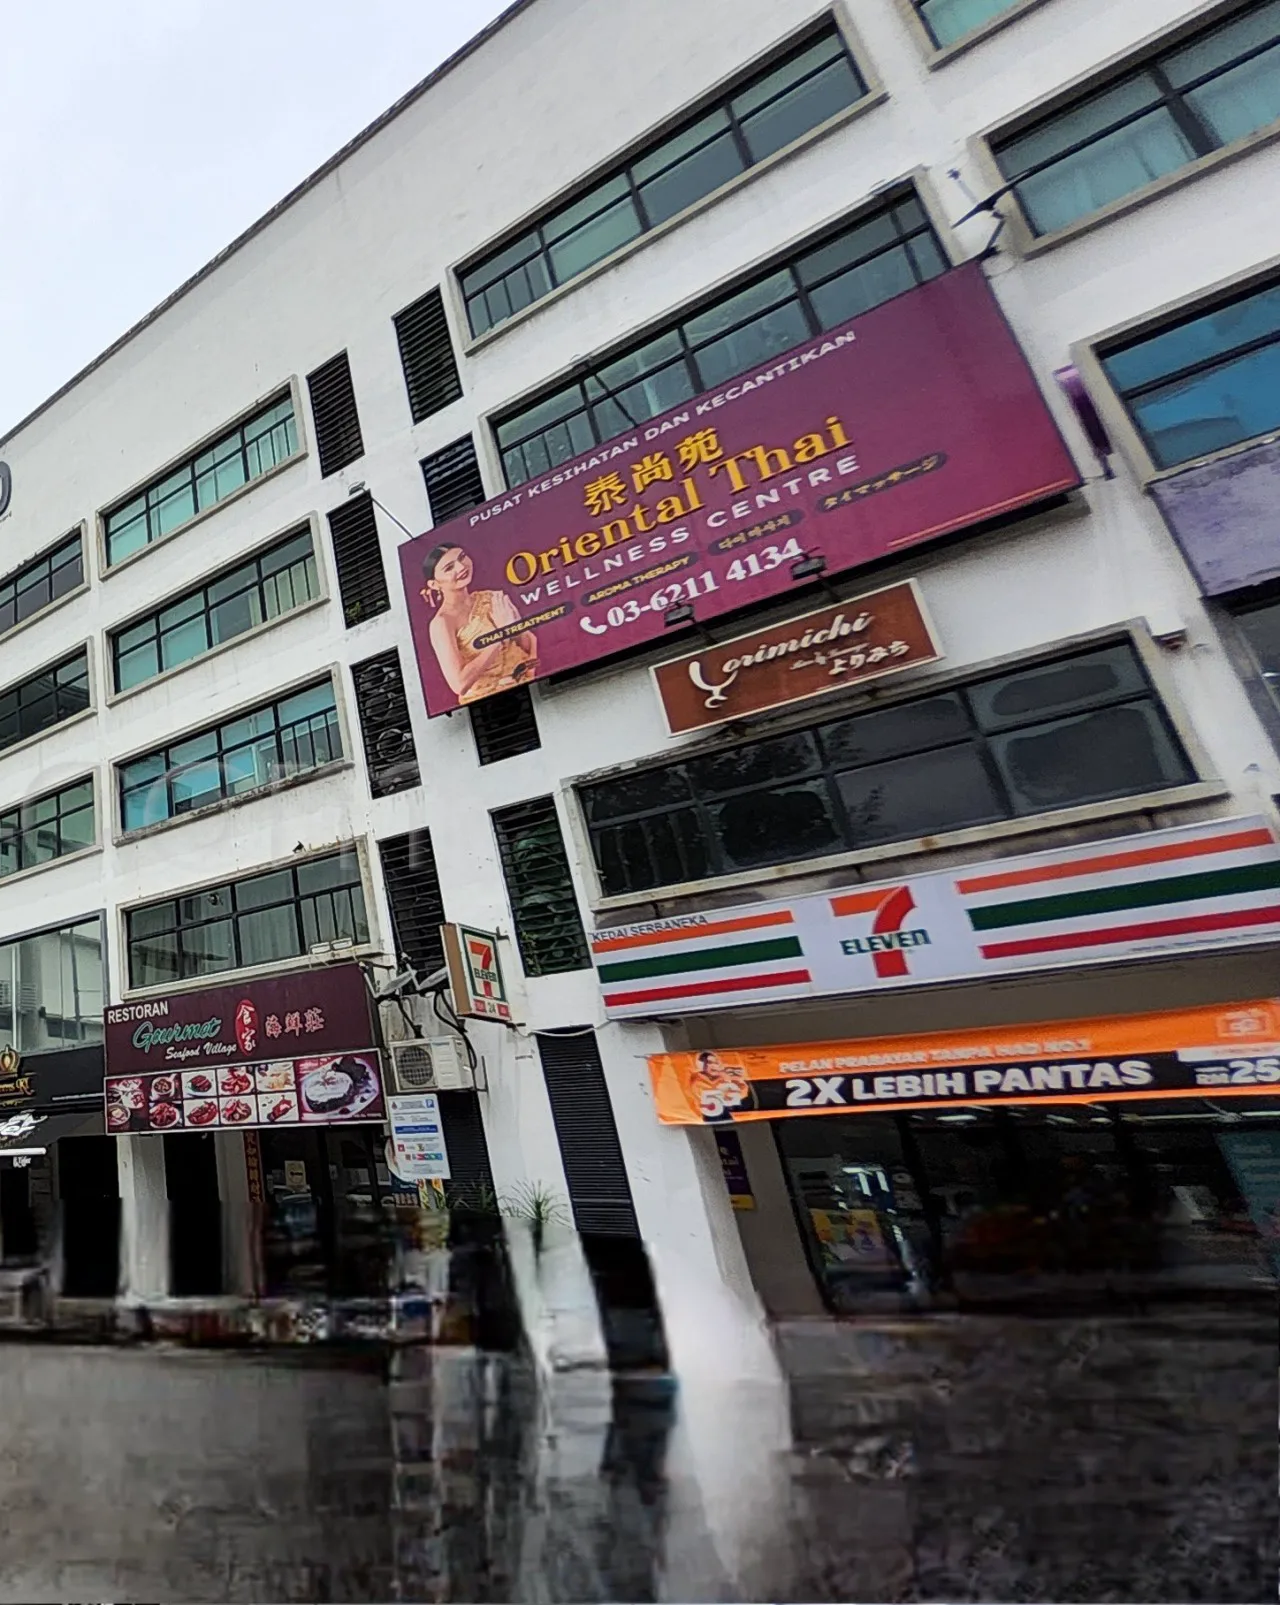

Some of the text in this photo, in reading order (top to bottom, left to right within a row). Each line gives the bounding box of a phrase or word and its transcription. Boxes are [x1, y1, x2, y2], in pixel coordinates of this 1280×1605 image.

[469, 330, 857, 527] PUSAT KESIHATAN DAN KECANTIKAN
[583, 426, 724, 517] 泰尚苑
[505, 415, 853, 586] Oriental Thai
[520, 454, 861, 606] WELLNESS CENTRE
[588, 555, 690, 602] AROMA THERAPY
[607, 537, 805, 628] 03-6211 4134
[479, 605, 567, 646] THAI TREATMENT
[828, 640, 911, 676] よりみち
[590, 914, 709, 944] KEDAI SERBANEKA
[829, 885, 917, 979] 7
[469, 940, 493, 997] 7
[107, 1000, 169, 1025] RESTORAN
[132, 1016, 222, 1053] Gourmet
[164, 1041, 237, 1061] Seafood Village
[785, 1059, 1155, 1107] 2X LEBIH PANTAS
